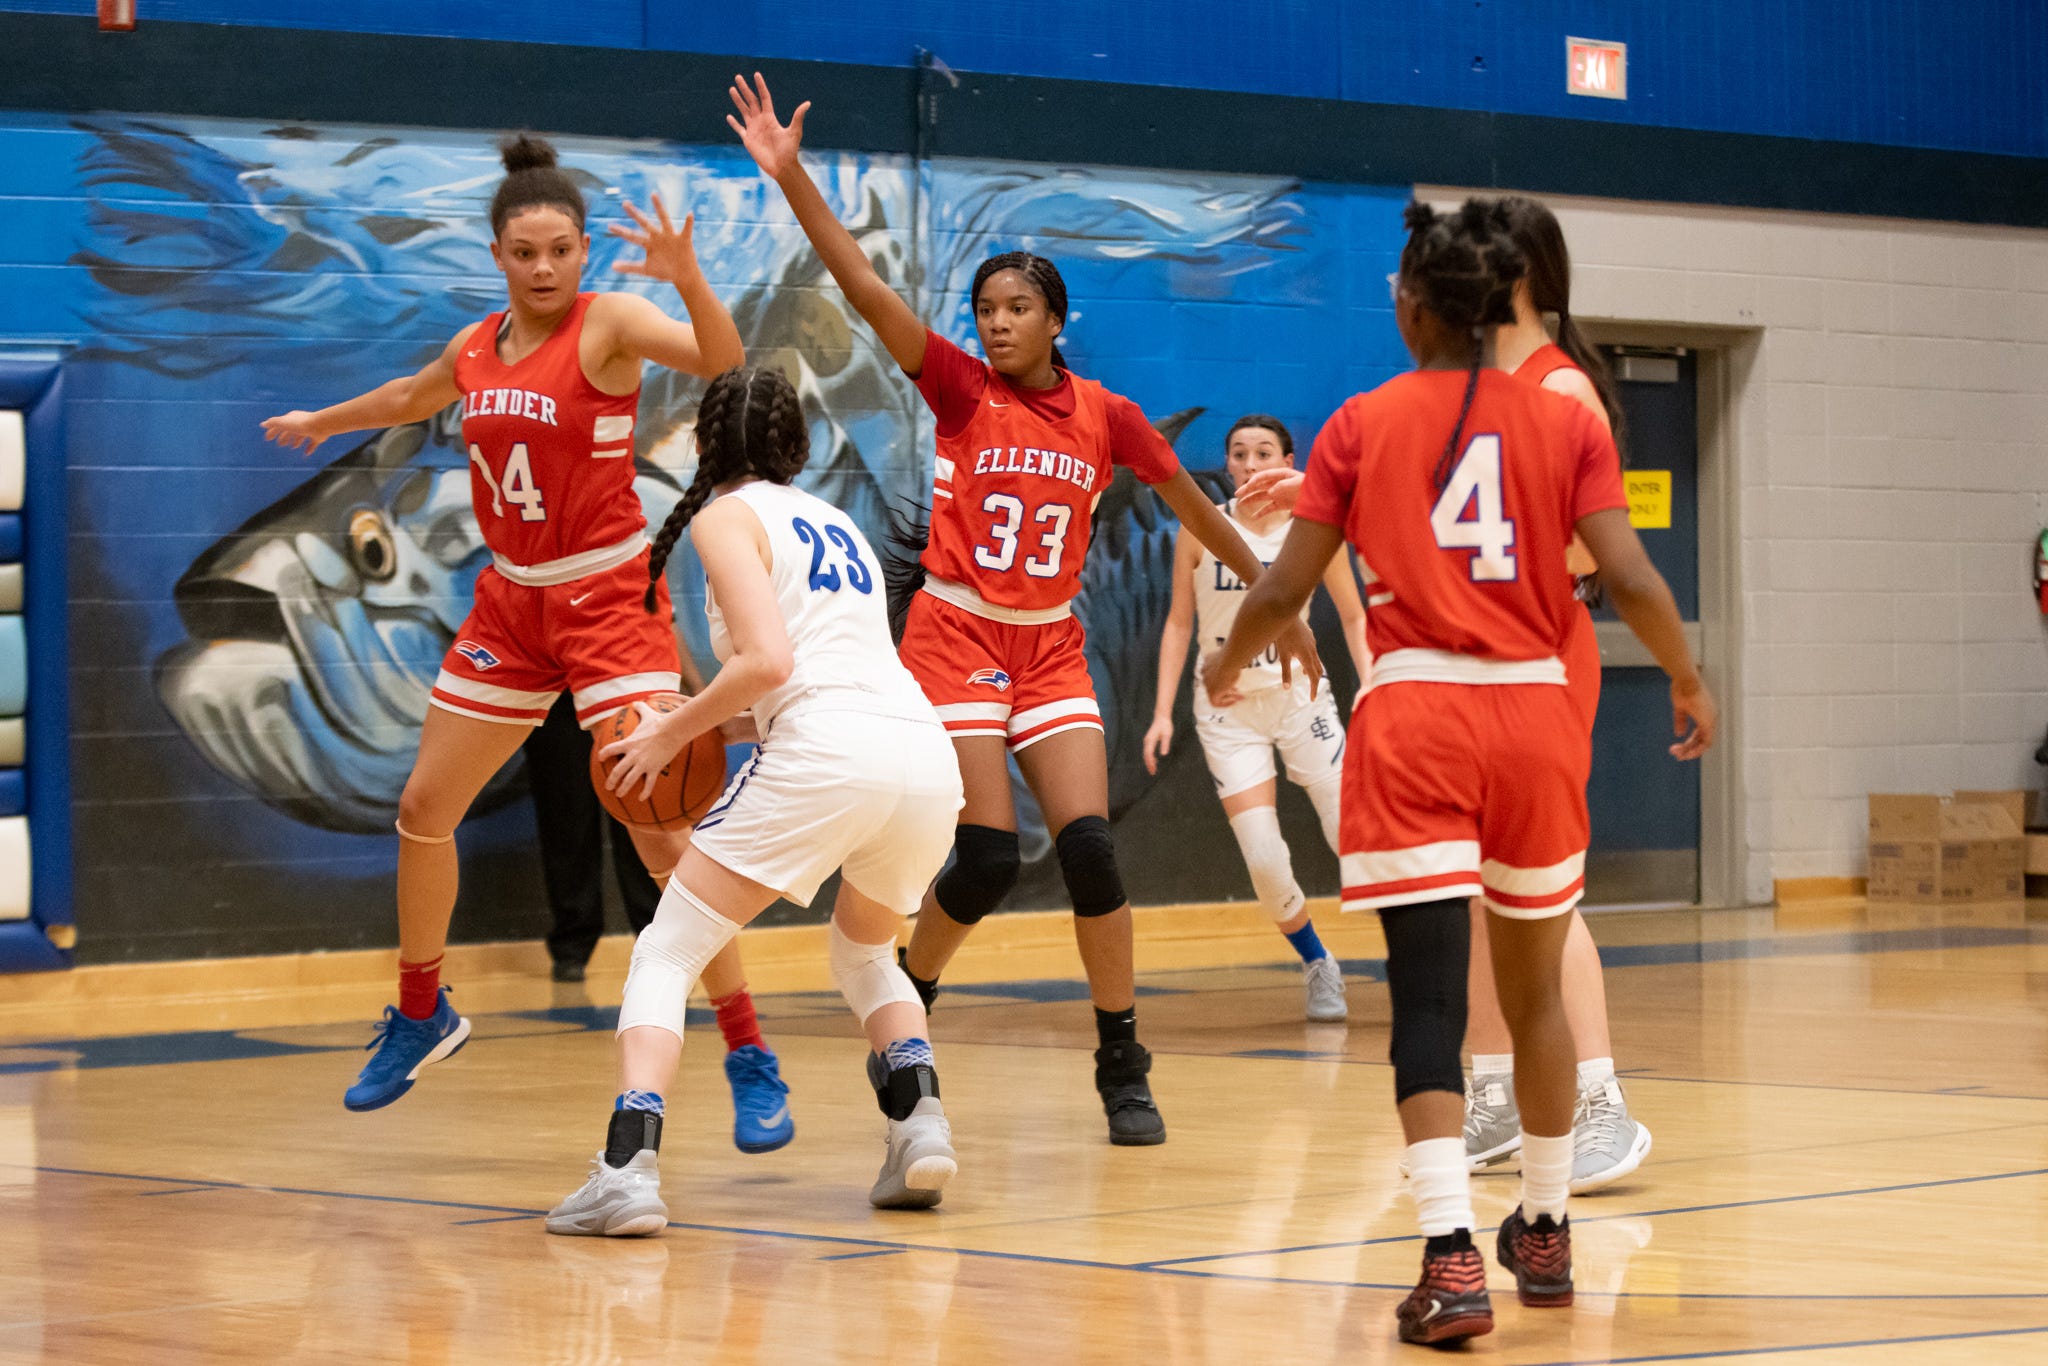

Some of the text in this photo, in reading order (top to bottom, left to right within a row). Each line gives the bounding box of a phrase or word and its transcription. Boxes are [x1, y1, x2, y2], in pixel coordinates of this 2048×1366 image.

[1571, 45, 1620, 91] EXIT
[469, 441, 547, 522] 14
[974, 447, 1096, 493] ELLENDER
[1430, 432, 1517, 582] 4
[791, 516, 872, 594] 23
[974, 492, 1072, 578] 33
